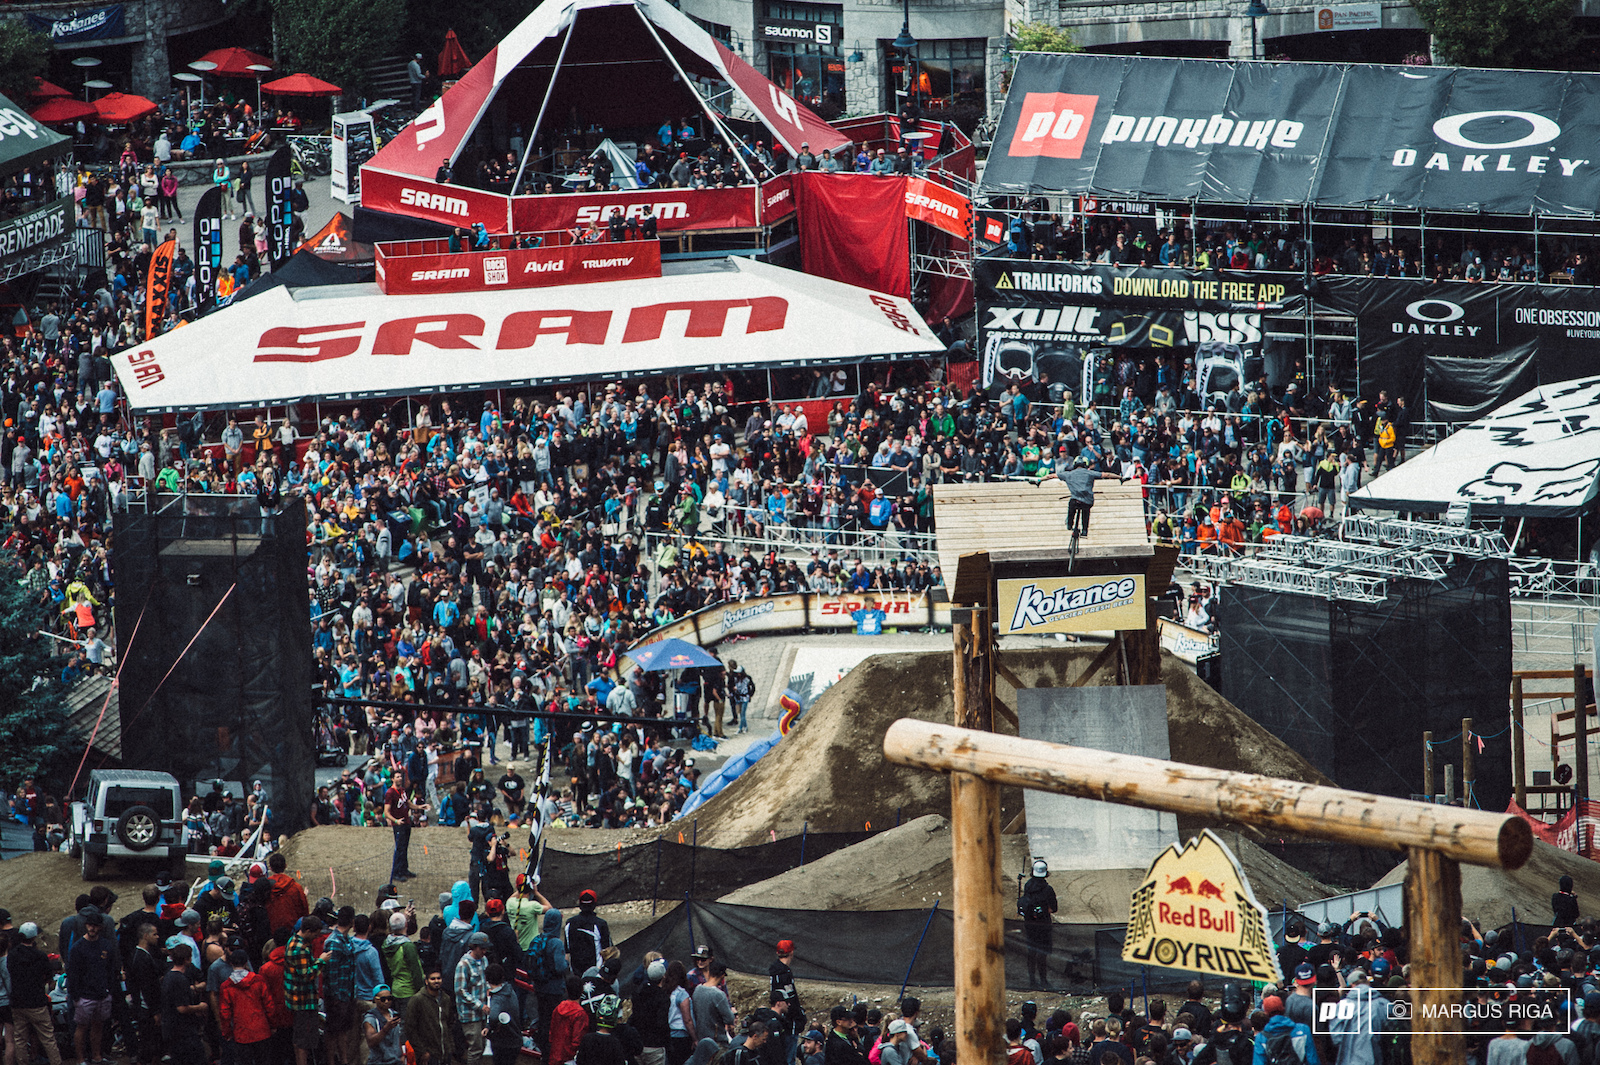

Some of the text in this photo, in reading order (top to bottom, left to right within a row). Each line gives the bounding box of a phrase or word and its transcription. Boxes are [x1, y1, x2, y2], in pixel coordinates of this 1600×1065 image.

[765, 26, 813, 39] salomon
[1021, 109, 1084, 142] pb
[1392, 149, 1585, 176] OAKLEY
[400, 187, 468, 216] SRAM
[905, 192, 959, 219] SRAM
[0, 210, 65, 257] RENEGADE
[411, 268, 470, 281] SRAM
[524, 260, 564, 273] Avid
[581, 257, 634, 269] TRUVATIV
[1012, 271, 1103, 294] TRAILFORKS
[1113, 277, 1285, 302] DOWNLOAD THE FREE APP
[1515, 308, 1538, 324] ONE
[253, 296, 789, 363] SRAM
[1023, 332, 1053, 341] OVER
[1053, 333, 1078, 342] FULL
[1392, 322, 1478, 337] OAKLEY
[721, 601, 774, 633] Kokanee
[1008, 577, 1136, 633] Kokanee
[1049, 598, 1134, 623] GLACIER FRESH BEER
[1174, 633, 1209, 653] Kokan
[1158, 902, 1235, 933] Red Bull
[1132, 937, 1270, 979] JOYRIDE
